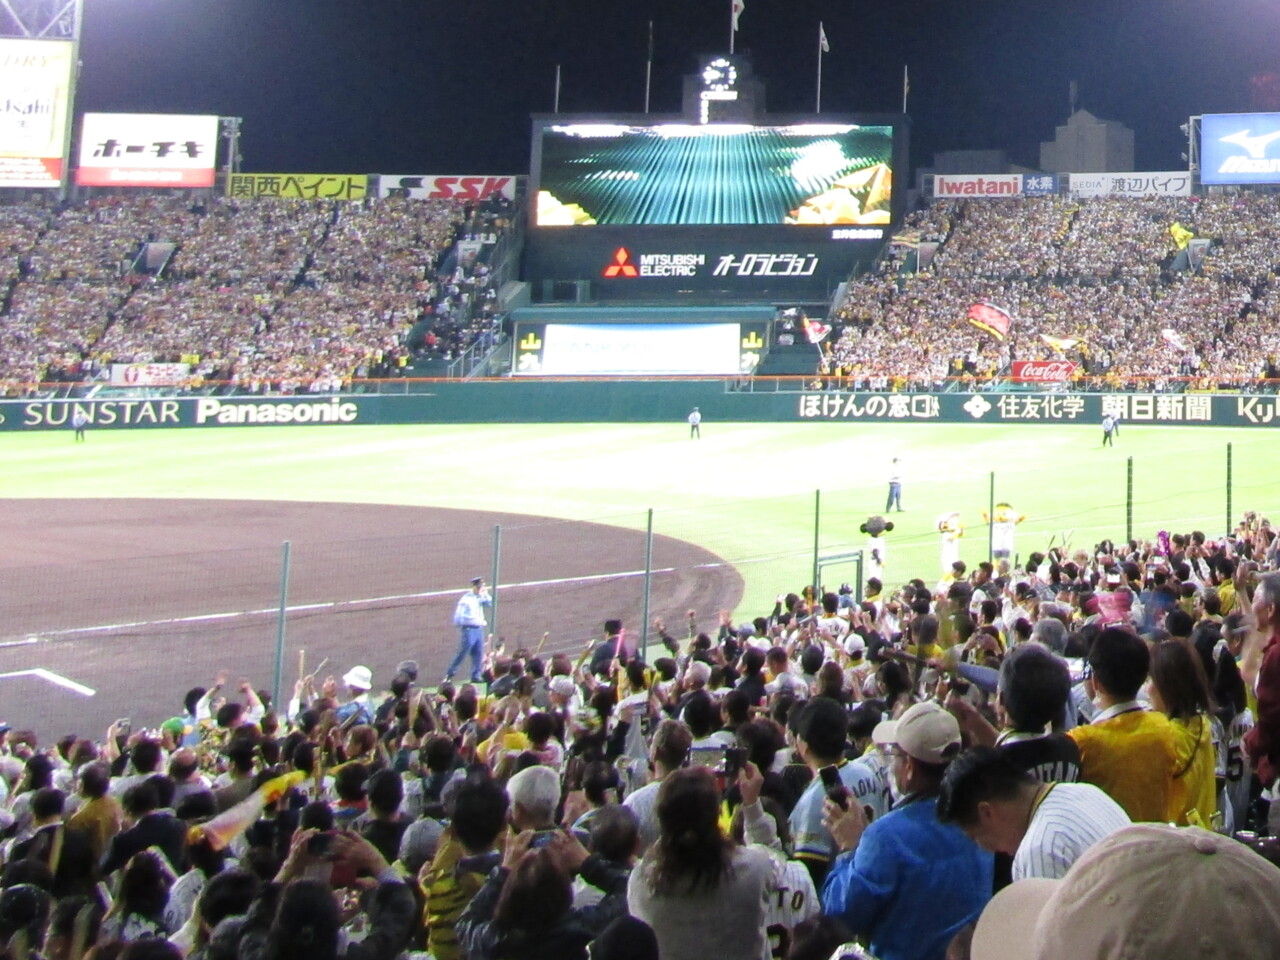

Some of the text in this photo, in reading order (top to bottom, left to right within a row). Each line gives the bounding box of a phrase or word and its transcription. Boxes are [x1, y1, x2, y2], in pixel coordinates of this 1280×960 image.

[92, 138, 205, 159] ホーチキ
[230, 175, 366, 197] 関西ペイント
[428, 177, 511, 199] SSK
[938, 177, 1019, 194] Iwatani
[1026, 176, 1053, 190] 水素
[1072, 181, 1102, 189] SEDIA
[1110, 176, 1190, 193] 渡辺パイプ
[640, 254, 705, 266] MITSUBISHI
[640, 265, 696, 276] ELECTRIC
[712, 253, 819, 276] オーロラビジョン
[518, 332, 542, 370] 山九
[24, 401, 180, 426] SUNSTAR
[197, 398, 358, 424] Panasonic
[799, 394, 940, 418] ほけんの窓口
[997, 395, 1085, 419] 住友化学
[1101, 395, 1212, 421] 朝日新聞
[1227, 746, 1243, 781] 5
